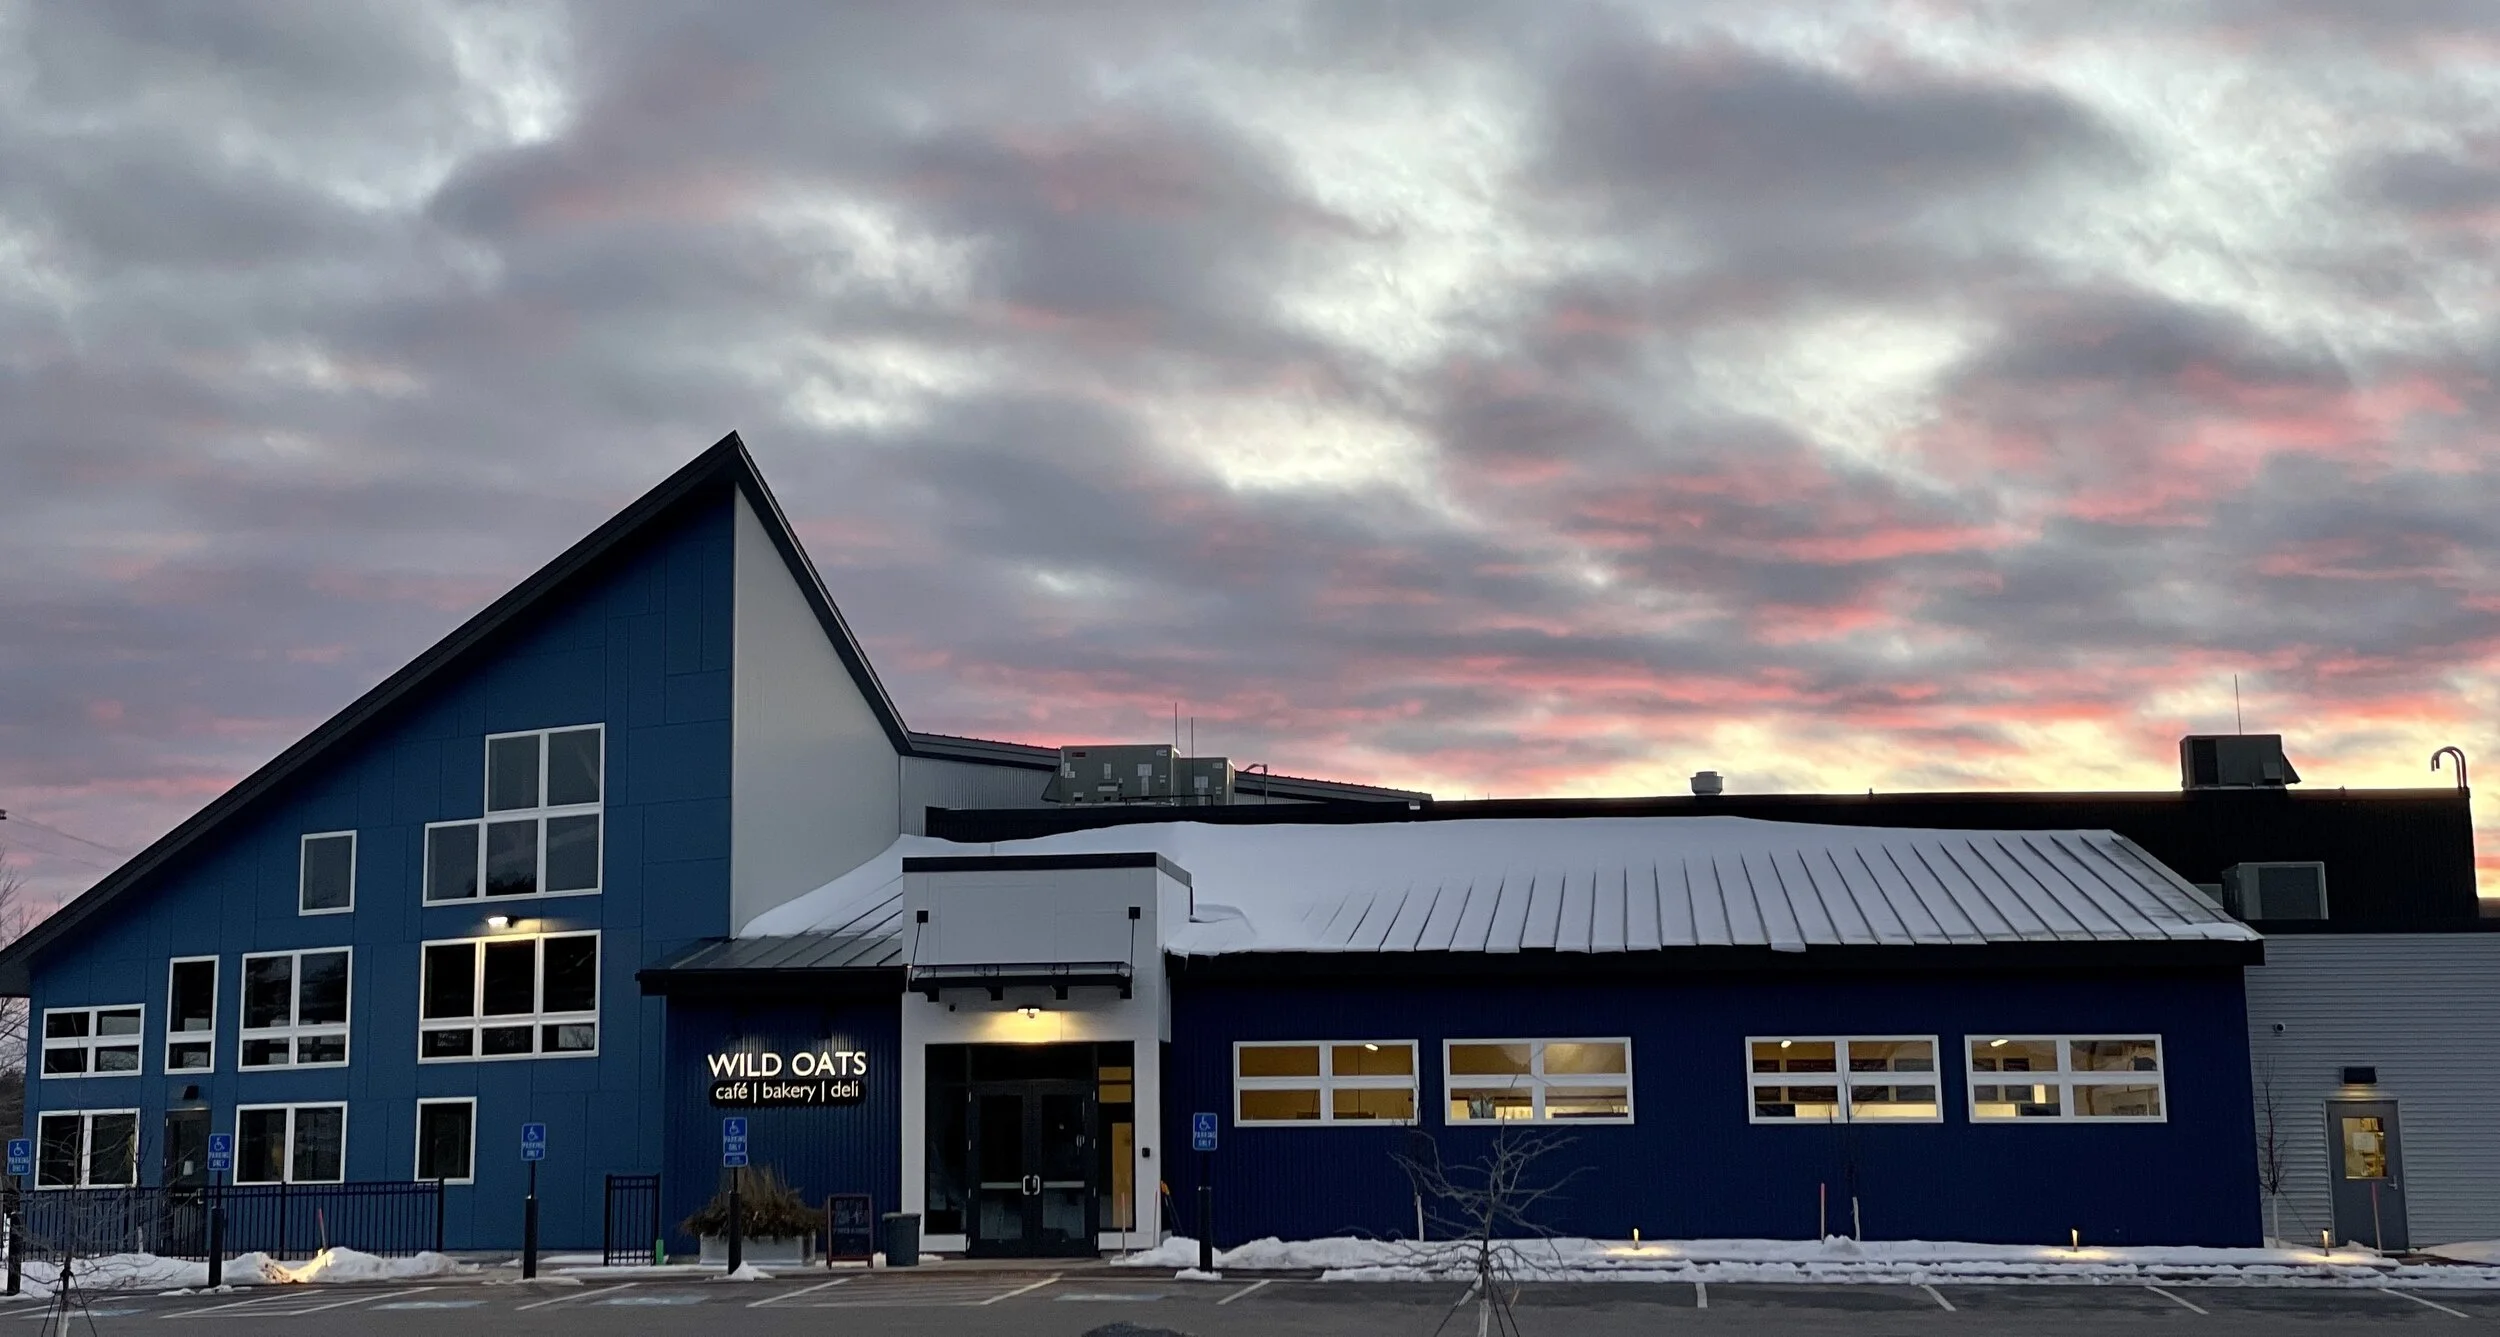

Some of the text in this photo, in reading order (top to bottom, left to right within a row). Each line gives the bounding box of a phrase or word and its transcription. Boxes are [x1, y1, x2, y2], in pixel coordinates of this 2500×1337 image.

[707, 1051, 867, 1077] WILD OATS
[715, 1081, 748, 1099] café
[762, 1081, 816, 1103] bakery
[830, 1080, 859, 1098] deli
